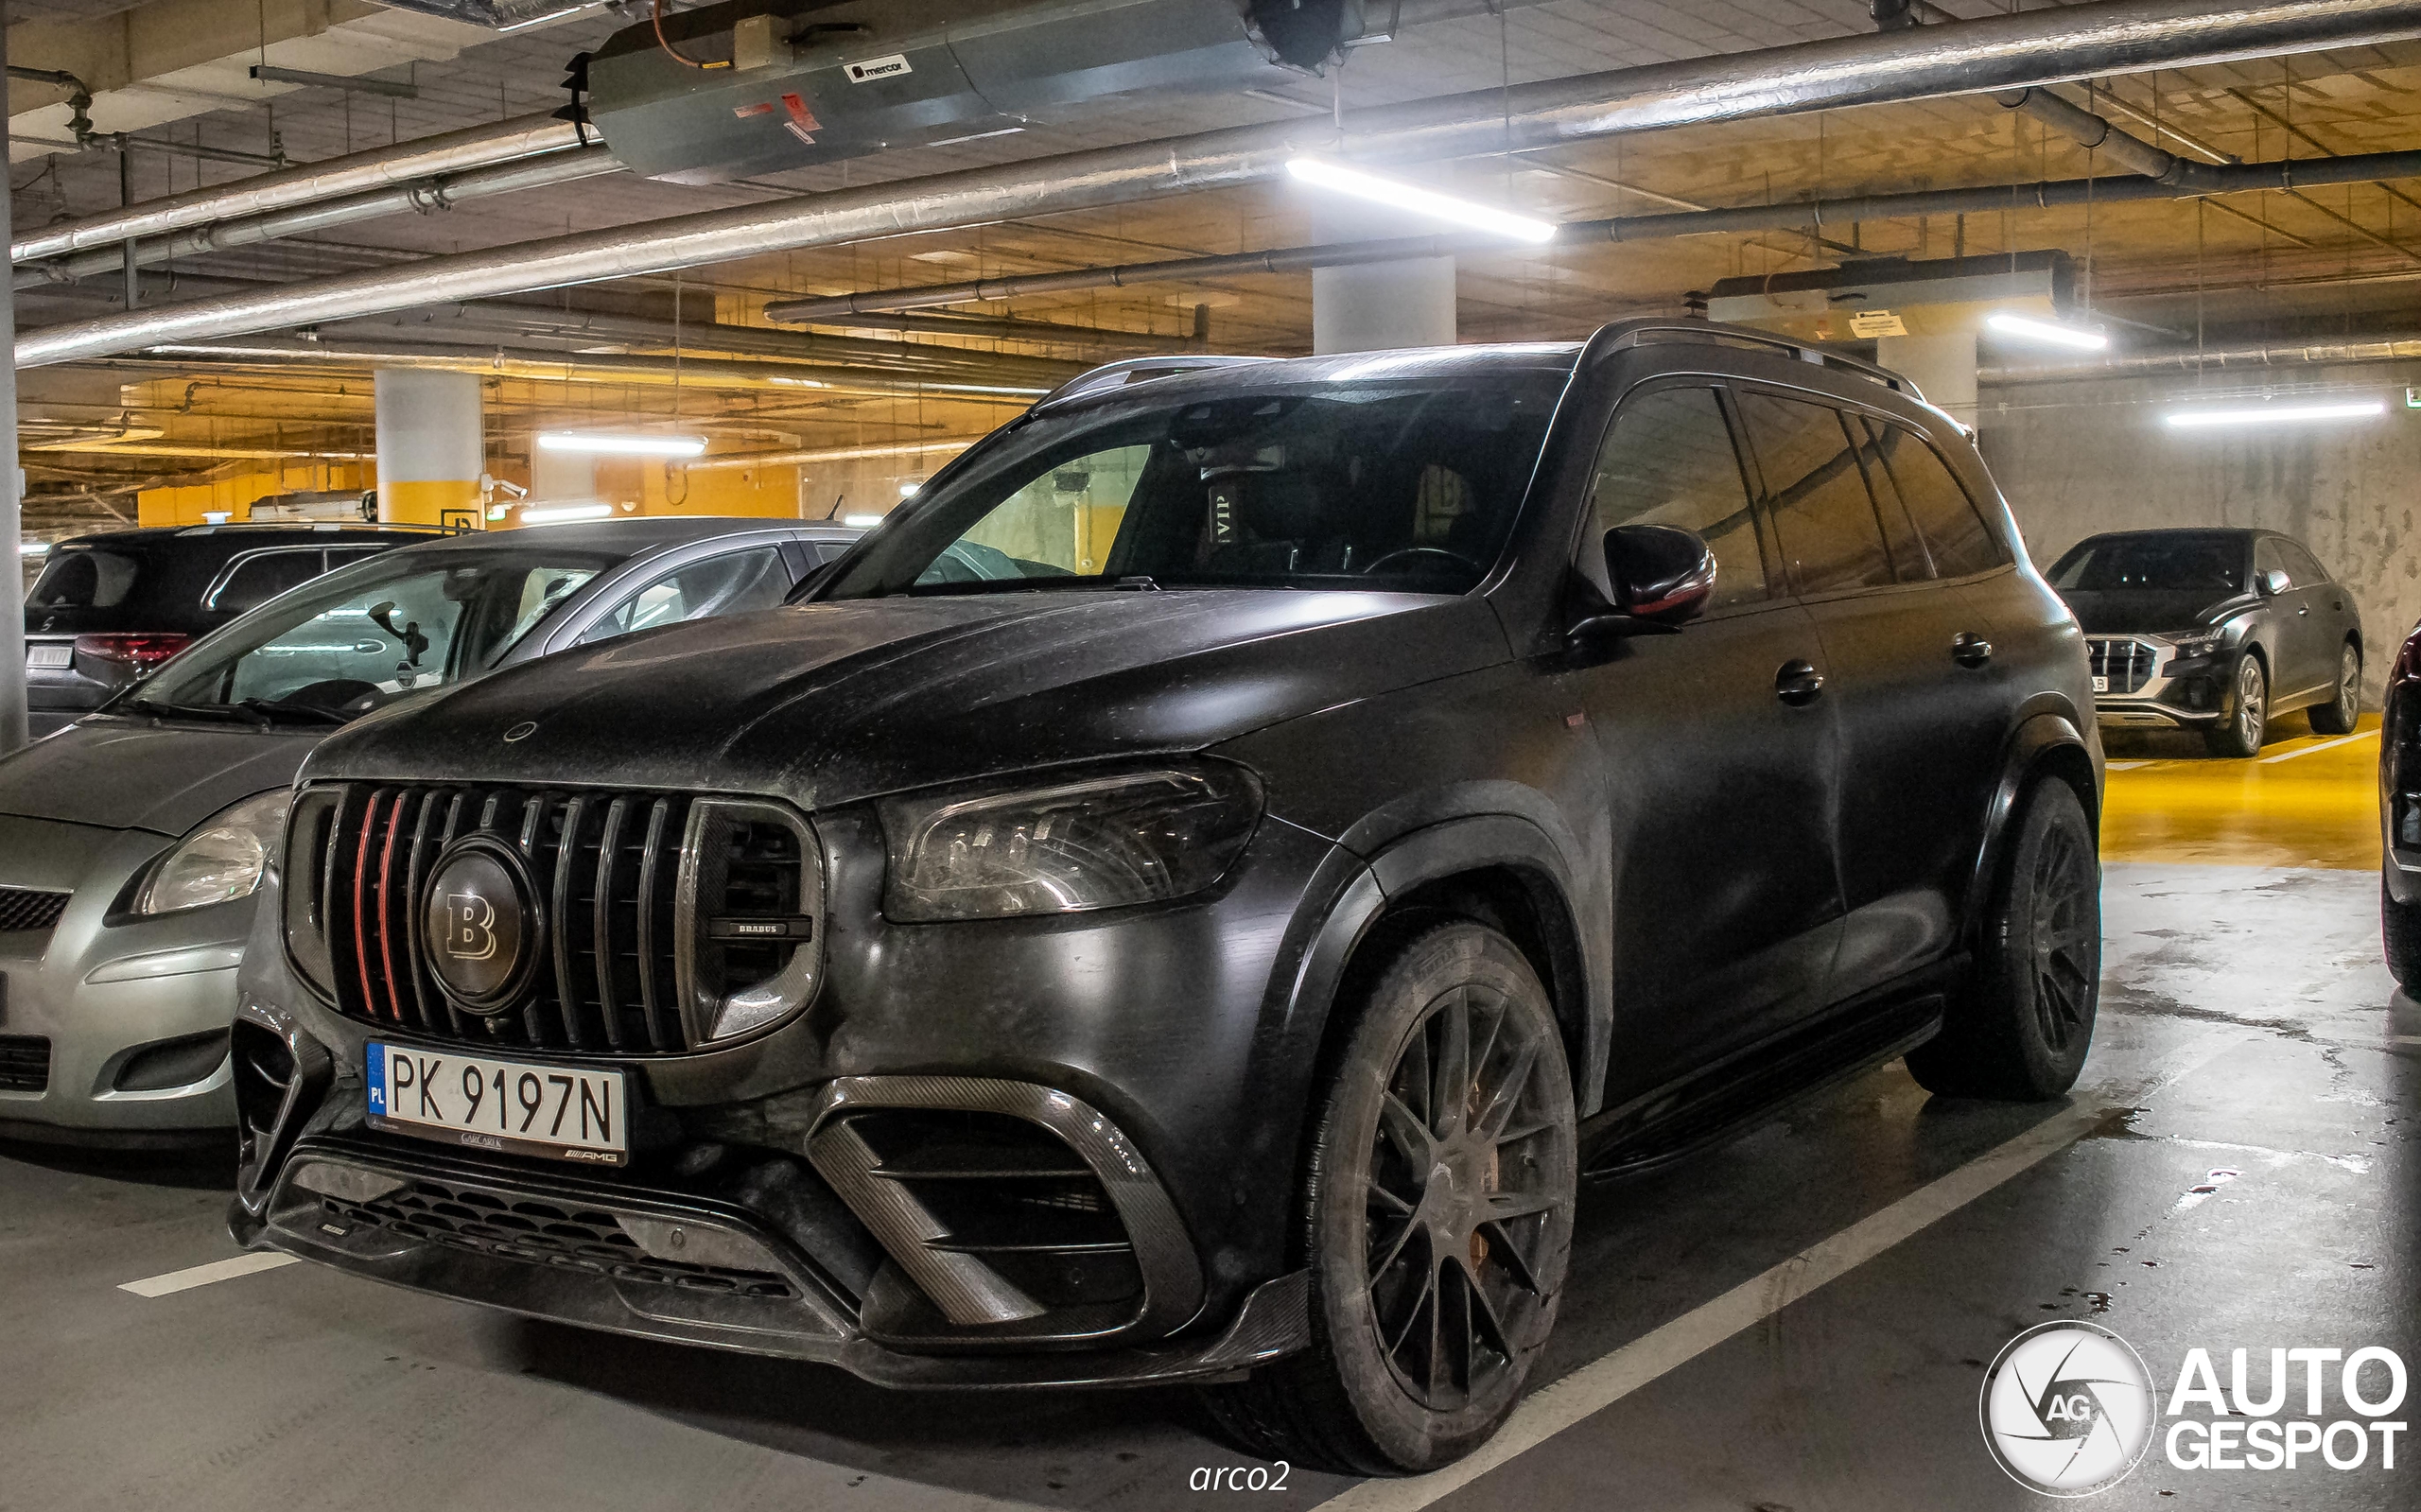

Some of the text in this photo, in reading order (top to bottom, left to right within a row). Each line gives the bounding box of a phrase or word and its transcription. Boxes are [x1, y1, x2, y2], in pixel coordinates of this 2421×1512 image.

[864, 62, 903, 76] mercor
[1216, 495, 1230, 536] VIP
[446, 893, 497, 961] B
[739, 925, 777, 933] BRABUS
[371, 1087, 385, 1104] PL
[392, 1053, 612, 1143] PK 9197N
